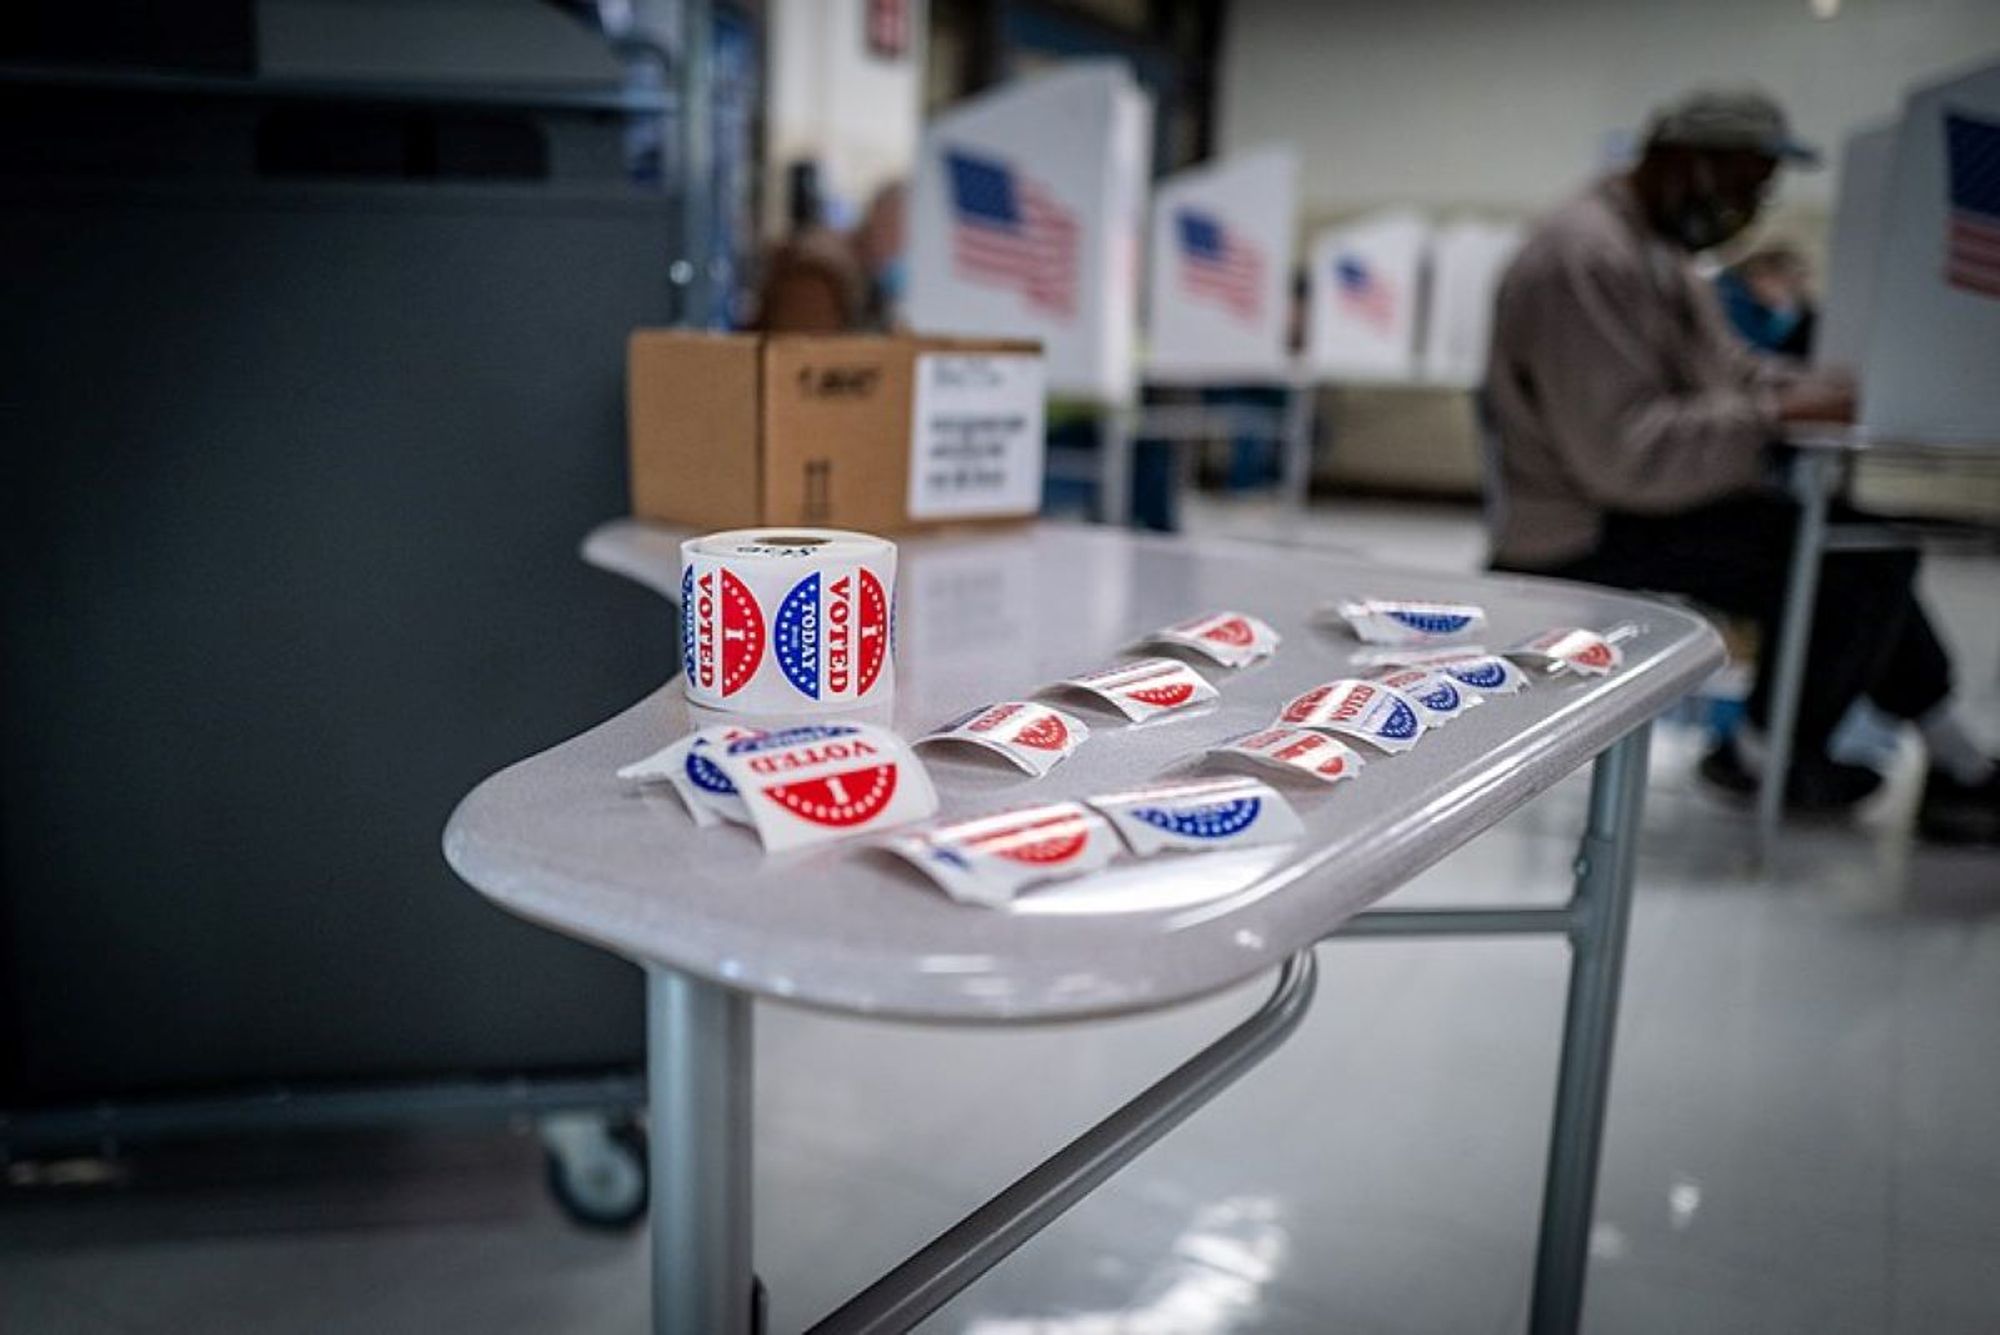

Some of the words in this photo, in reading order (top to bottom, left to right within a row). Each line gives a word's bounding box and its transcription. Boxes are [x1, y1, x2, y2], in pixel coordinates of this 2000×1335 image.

[698, 572, 714, 688] VOTED
[725, 627, 745, 641] I
[802, 602, 817, 669] TODAY
[829, 575, 849, 693] VOTED
[862, 626, 878, 639] I
[749, 740, 878, 773] VOTED
[826, 775, 849, 804] I
